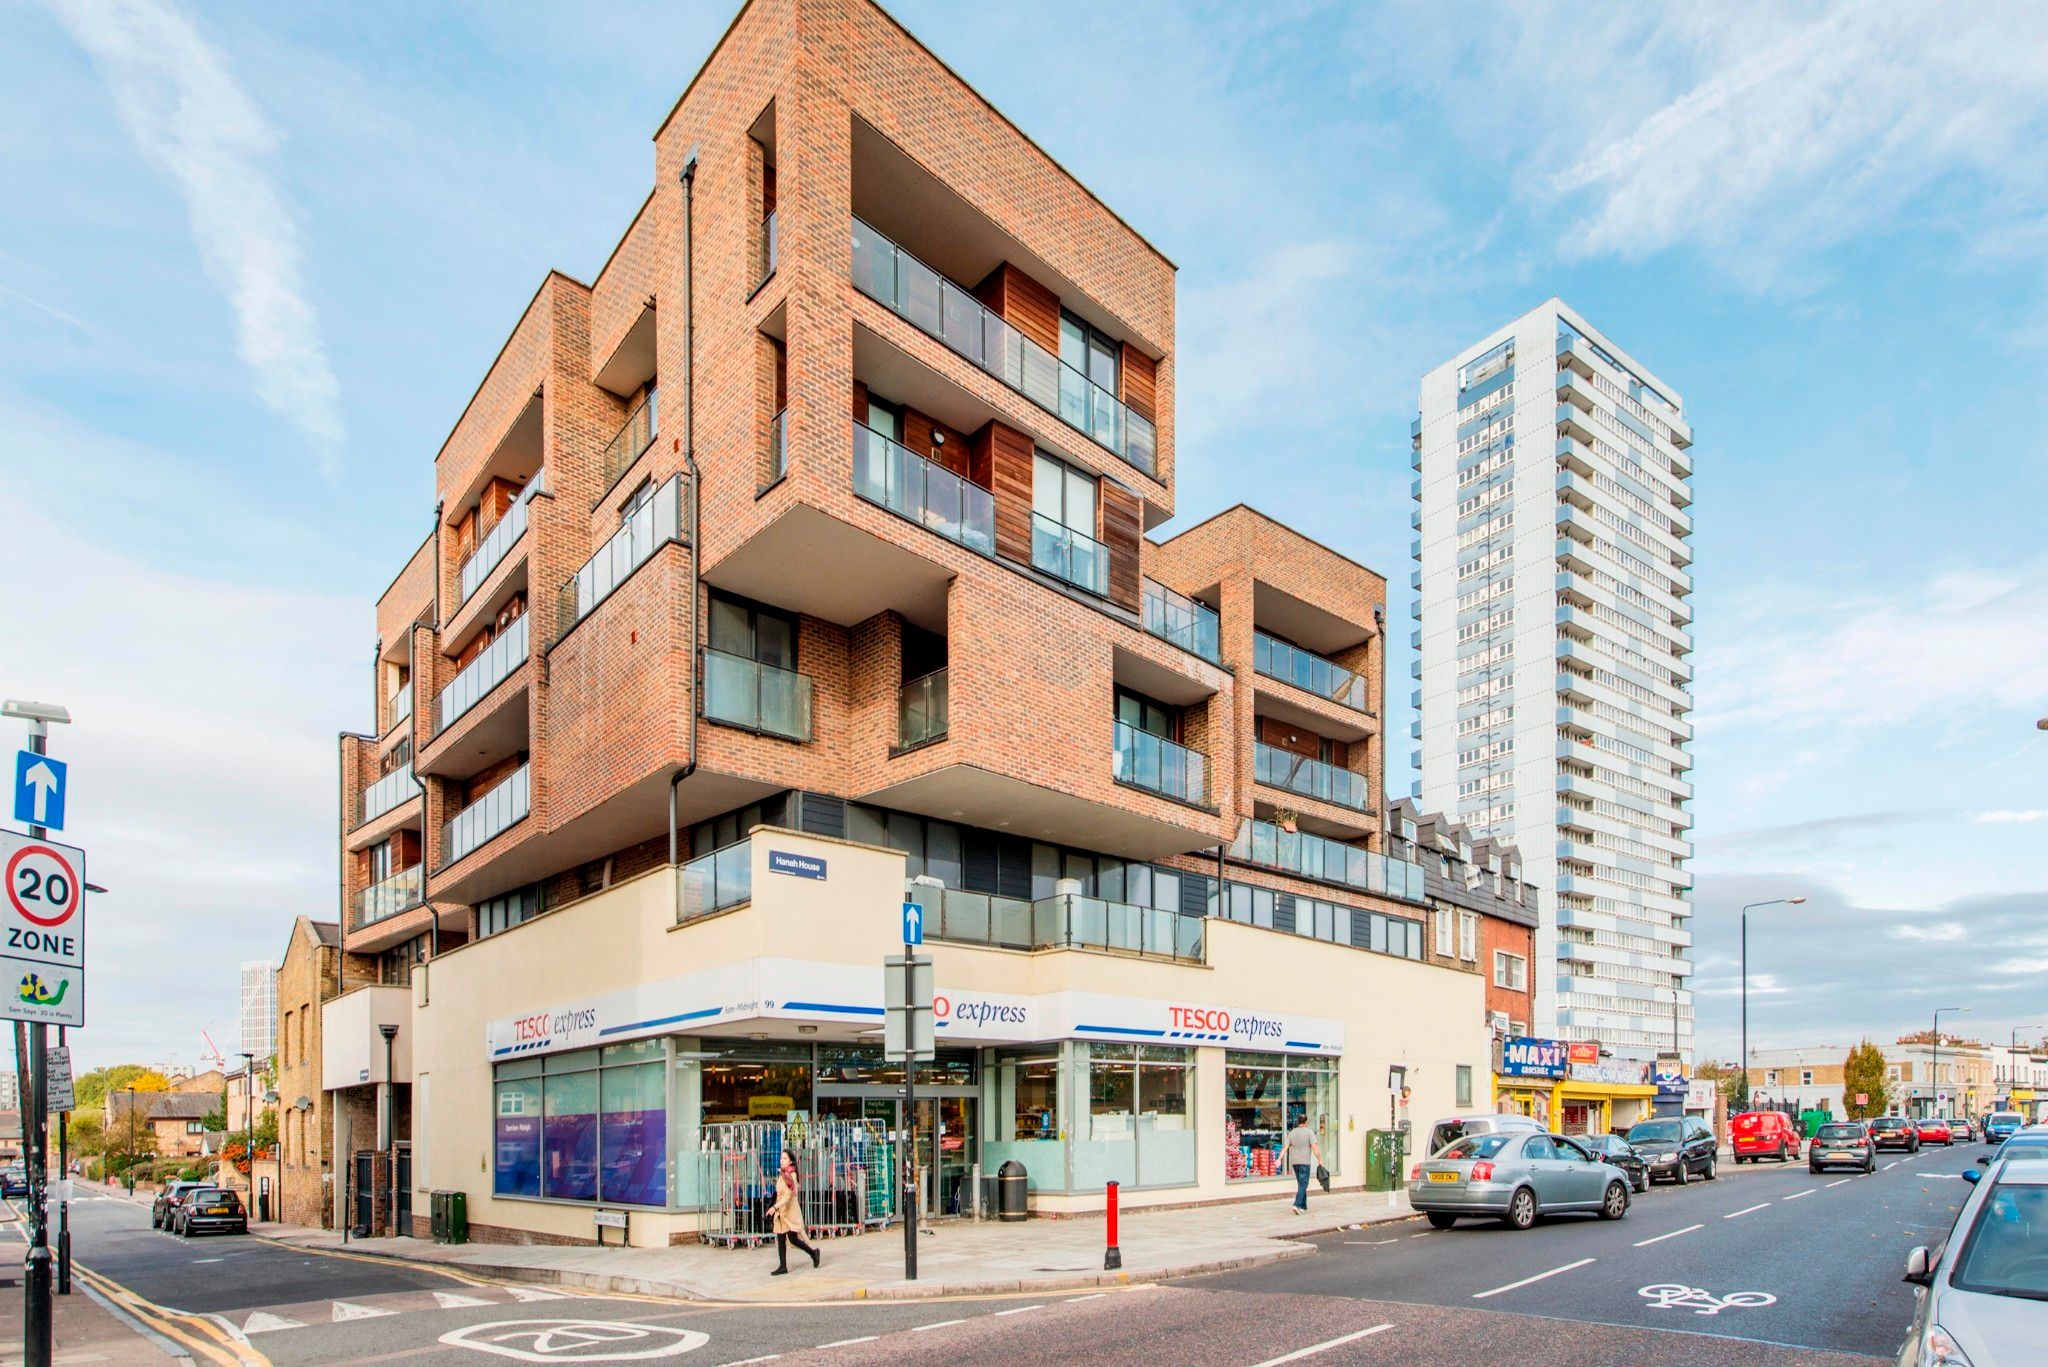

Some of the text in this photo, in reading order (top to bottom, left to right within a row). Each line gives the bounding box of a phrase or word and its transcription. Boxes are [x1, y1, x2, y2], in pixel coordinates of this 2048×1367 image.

[775, 856, 820, 871] Hanah House
[19, 867, 69, 906] 20
[8, 927, 75, 956] ZONE
[764, 1000, 775, 1009] 99
[956, 1001, 1026, 1028] express
[514, 1008, 595, 1041] TESCO express
[1168, 1006, 1283, 1041] TESCO express
[1509, 1044, 1560, 1066] MAXI
[752, 1102, 772, 1110] Special
